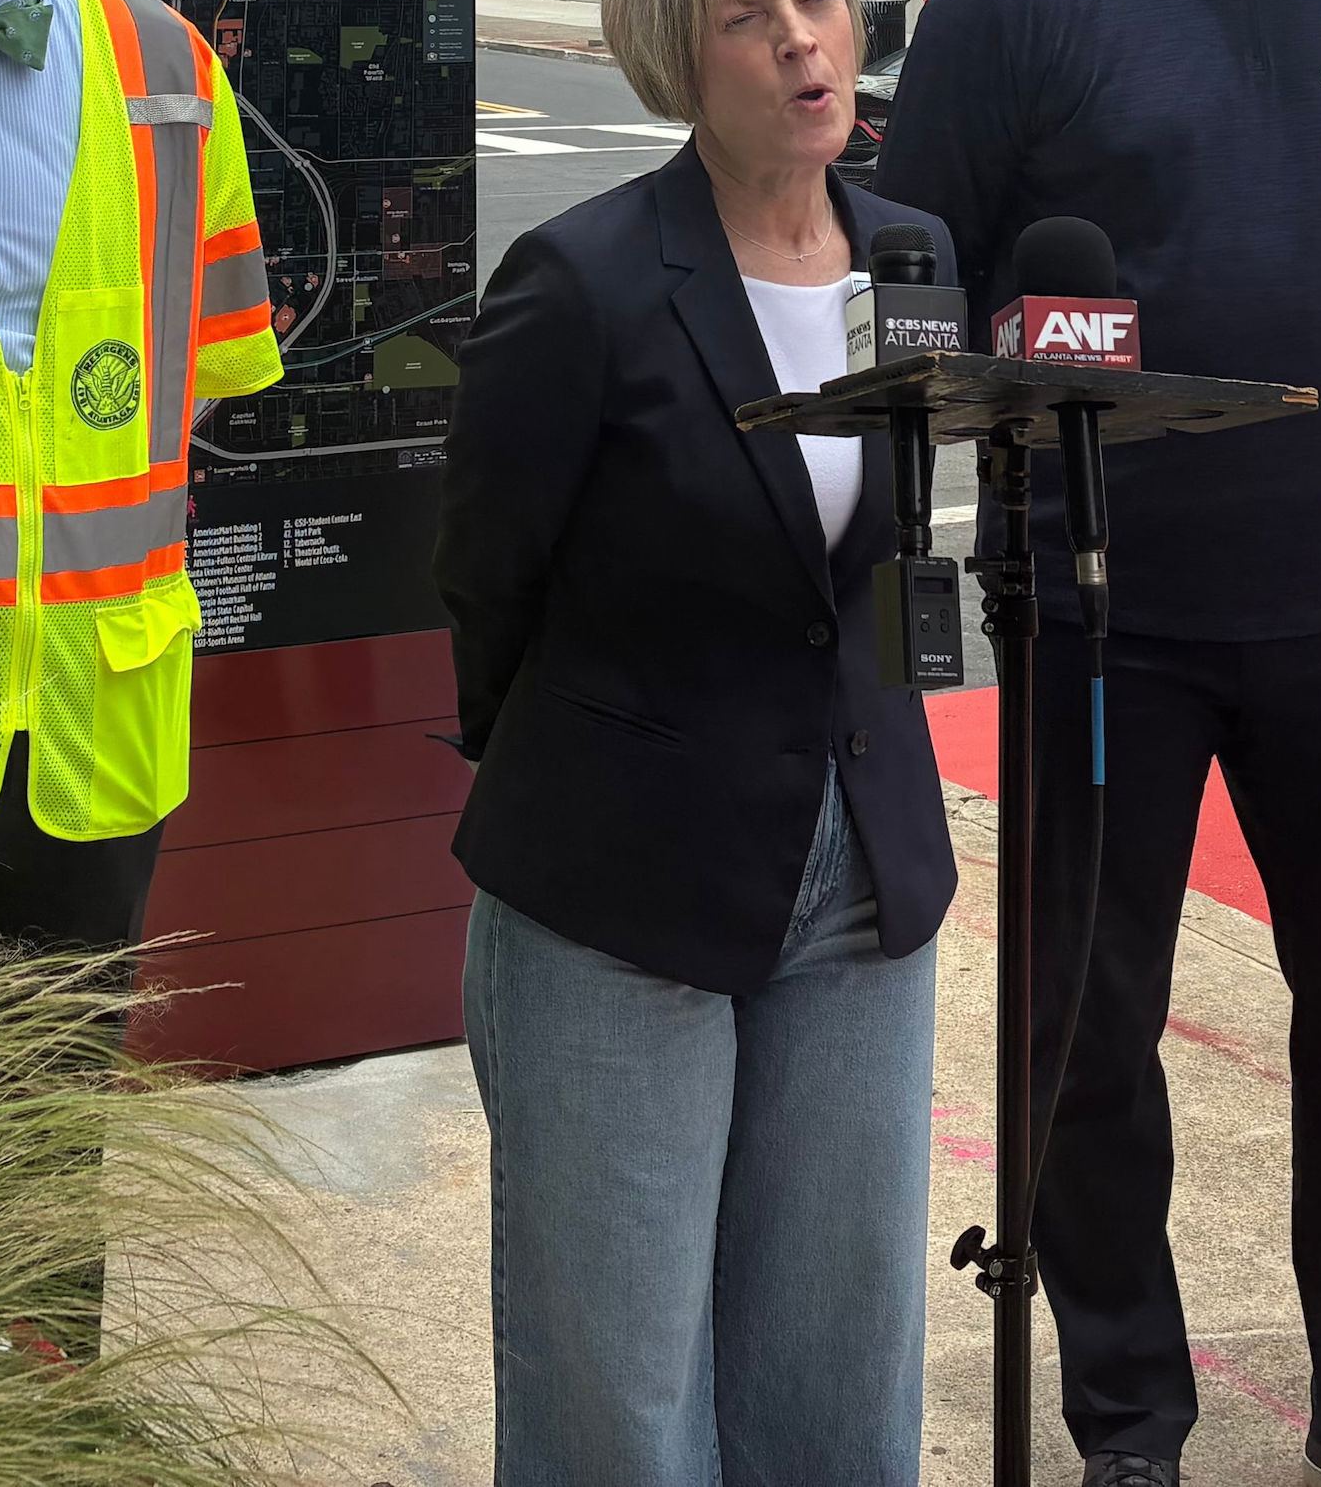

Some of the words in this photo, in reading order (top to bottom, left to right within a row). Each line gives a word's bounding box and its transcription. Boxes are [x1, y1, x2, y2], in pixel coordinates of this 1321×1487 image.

[896, 318, 921, 330] CBS
[922, 320, 959, 333] NEWS
[1034, 311, 1135, 351] ANF
[884, 331, 961, 350] ATLANTA
[1033, 352, 1073, 361] ATLANTA
[1074, 354, 1103, 362] NEWS
[1104, 355, 1133, 363] FIRST
[920, 654, 953, 663] SONY
